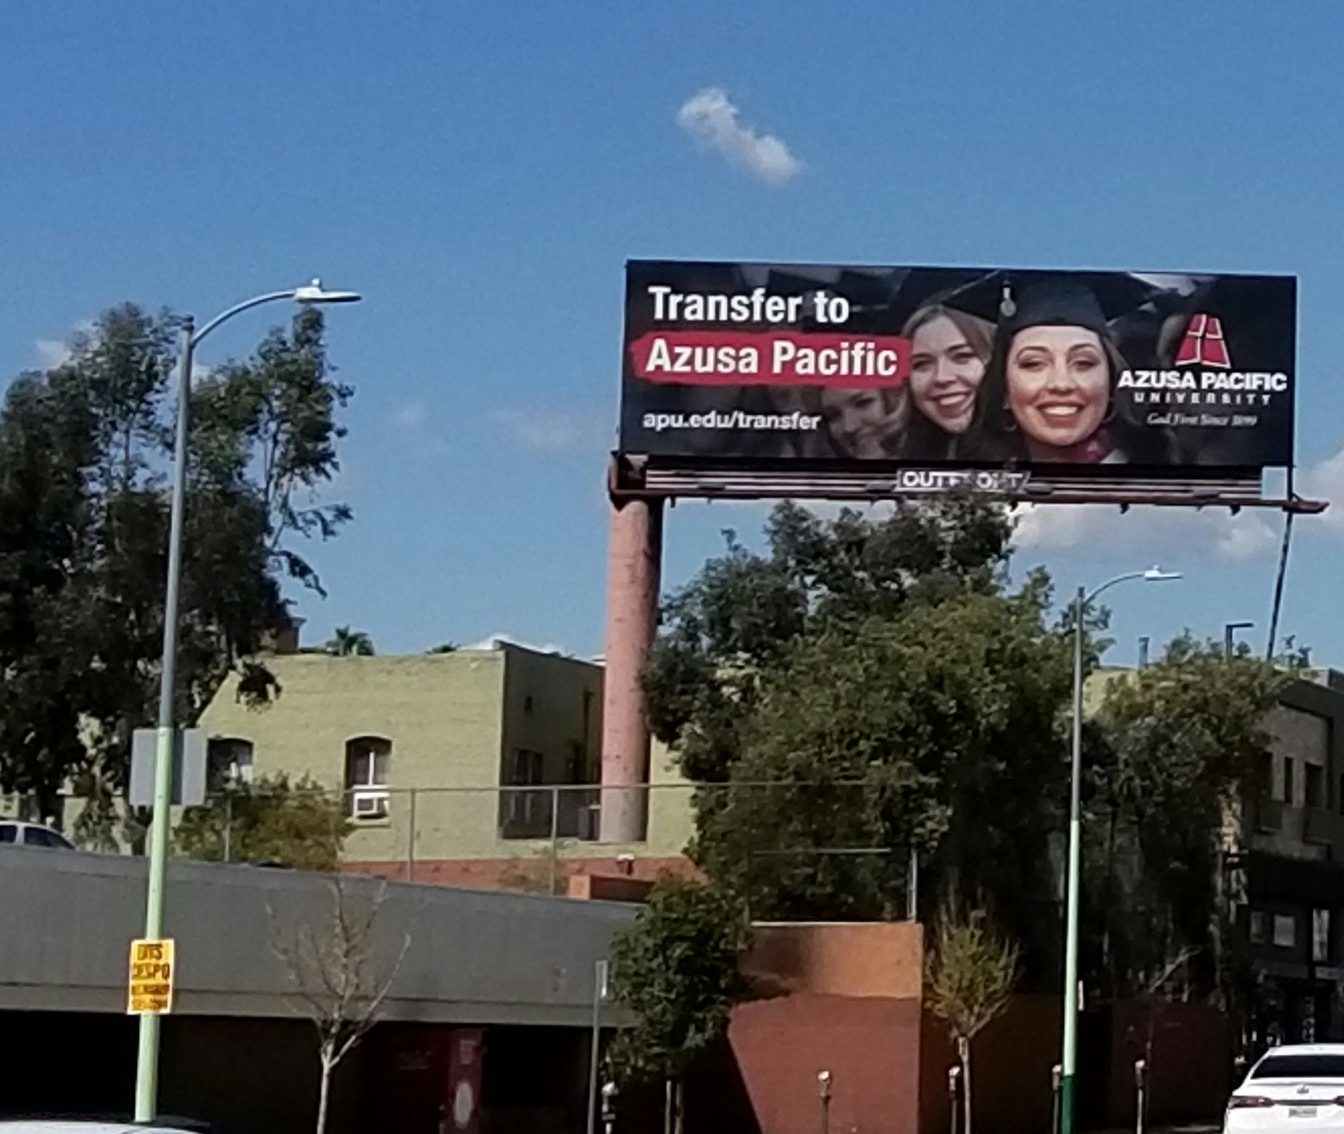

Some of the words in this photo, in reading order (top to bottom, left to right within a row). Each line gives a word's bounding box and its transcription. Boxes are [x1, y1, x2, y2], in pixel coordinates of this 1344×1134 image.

[648, 285, 804, 325] Transfer
[814, 290, 851, 325] to
[645, 337, 759, 375] Azusa
[772, 338, 899, 377] Pacific
[1117, 370, 1197, 389] AZUSA
[1201, 372, 1288, 392] PACIFIC
[1134, 391, 1271, 406] UNIVERSITY
[643, 410, 821, 435] apu.edu/transfer
